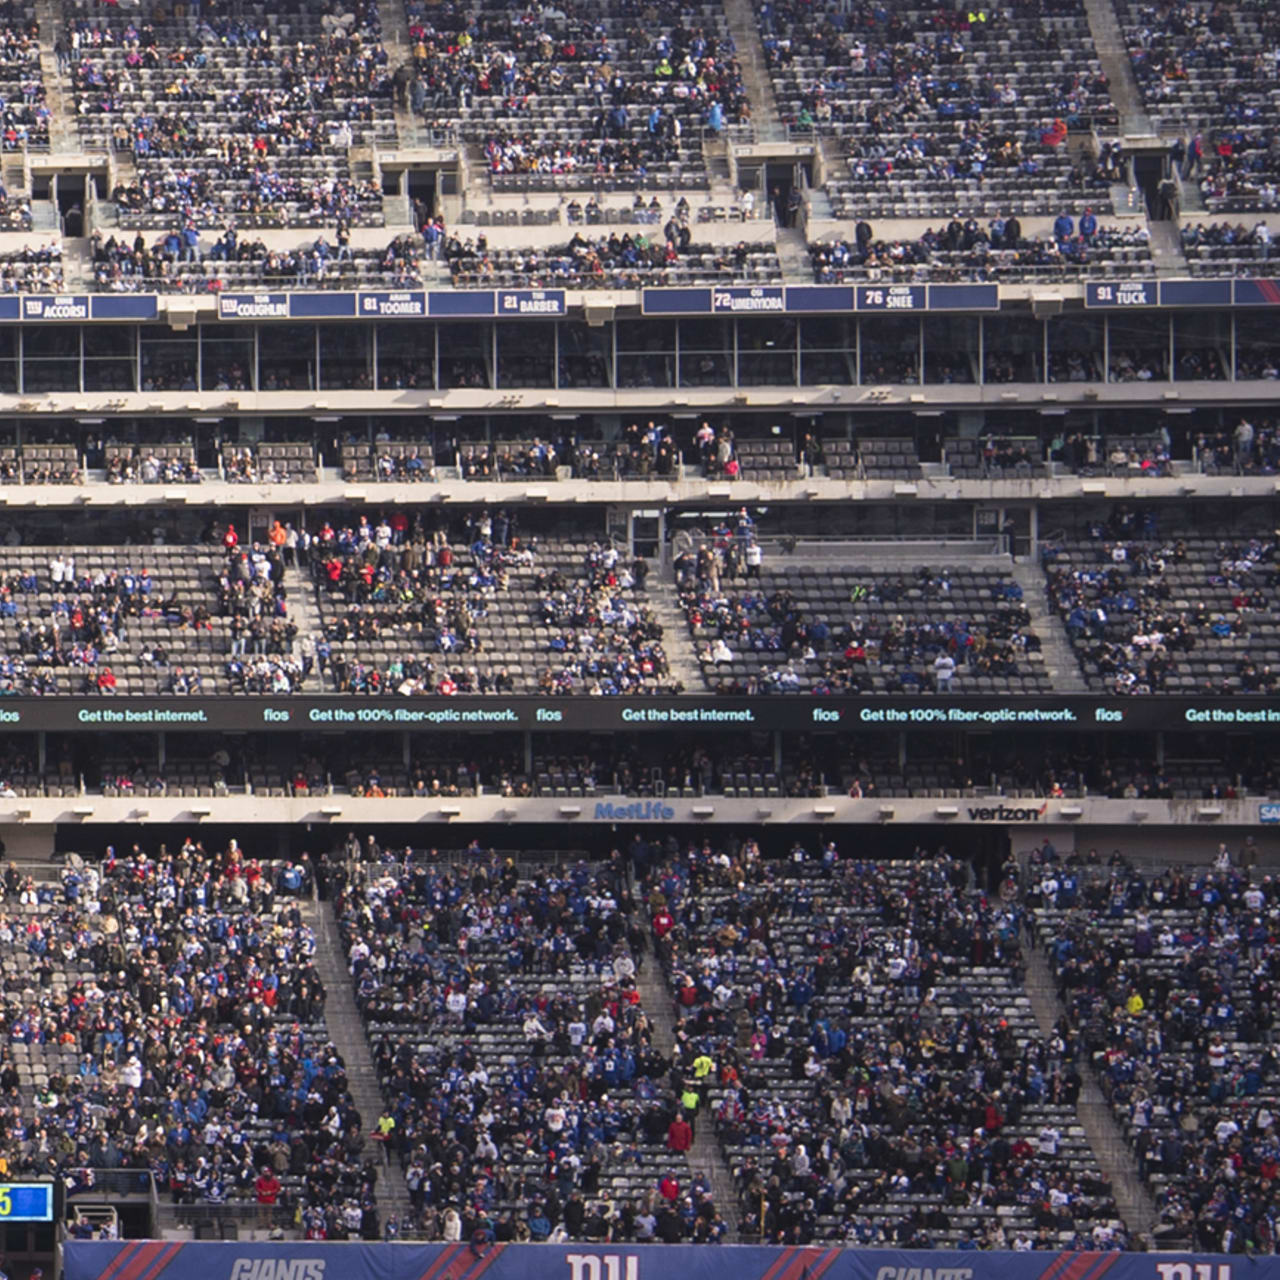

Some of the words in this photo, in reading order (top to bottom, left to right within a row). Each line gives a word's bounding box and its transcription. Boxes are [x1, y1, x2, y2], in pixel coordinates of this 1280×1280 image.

[866, 291, 883, 304] 76
[886, 296, 913, 308] SNEE
[1097, 287, 1112, 300] 91
[1116, 292, 1146, 304] TUCK
[237, 303, 288, 316] COUGHLIN
[364, 298, 377, 310] 81
[380, 302, 421, 314] TOOMER
[504, 296, 517, 308] 21
[520, 300, 559, 312] BARBER
[43, 306, 86, 318] ACCORSI
[78, 708, 102, 723] Get
[103, 709, 125, 722] the
[125, 709, 154, 722] best
[154, 709, 208, 722] internet.
[263, 708, 290, 722] fios
[813, 708, 840, 722] fios
[861, 708, 886, 722] Get
[886, 708, 910, 722] the
[911, 708, 949, 722] 100%
[949, 708, 1018, 723] fiber-optic
[1018, 708, 1077, 721] network.
[1095, 707, 1123, 722] fios
[1186, 708, 1211, 722] Get
[1212, 709, 1235, 722] the
[1235, 709, 1265, 722] best
[593, 800, 675, 820] MetLife
[967, 804, 1040, 821] verizon
[1261, 806, 1280, 818] SA
